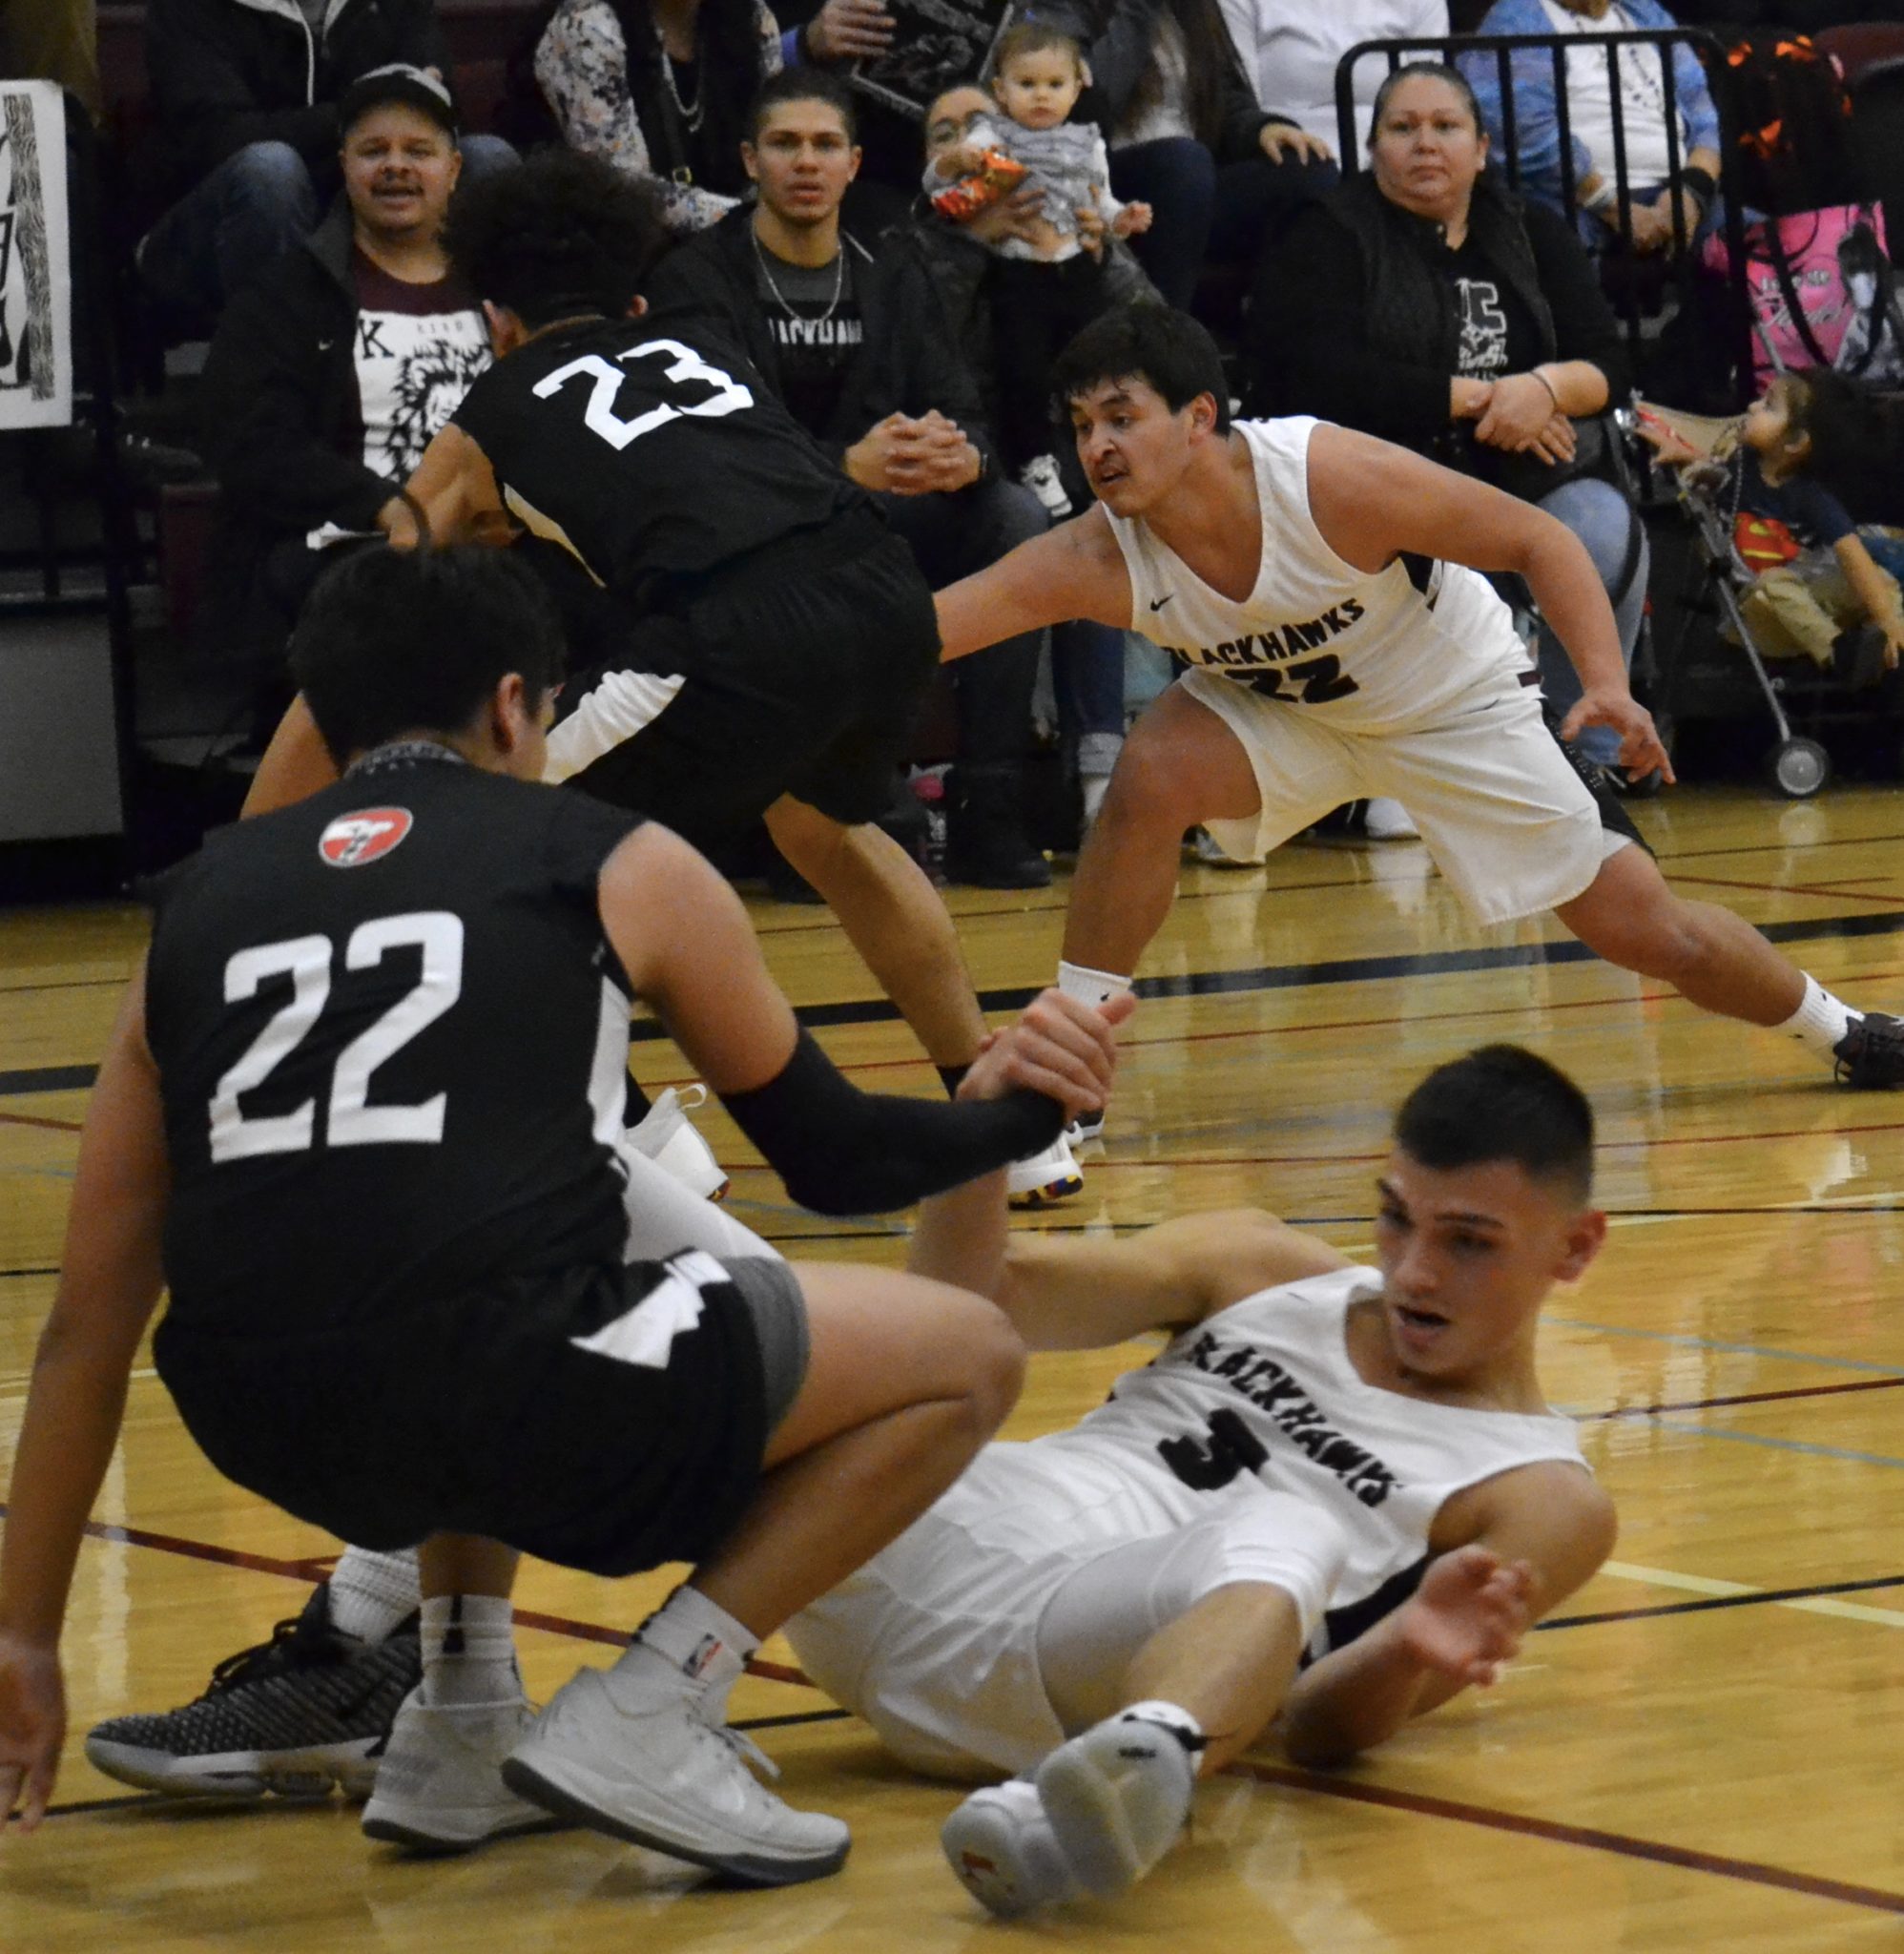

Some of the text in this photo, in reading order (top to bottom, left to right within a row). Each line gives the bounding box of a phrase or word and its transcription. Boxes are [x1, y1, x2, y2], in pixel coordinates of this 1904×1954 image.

[532, 339, 755, 451] 23
[1224, 654, 1360, 704] 22
[208, 910, 465, 1164] 22
